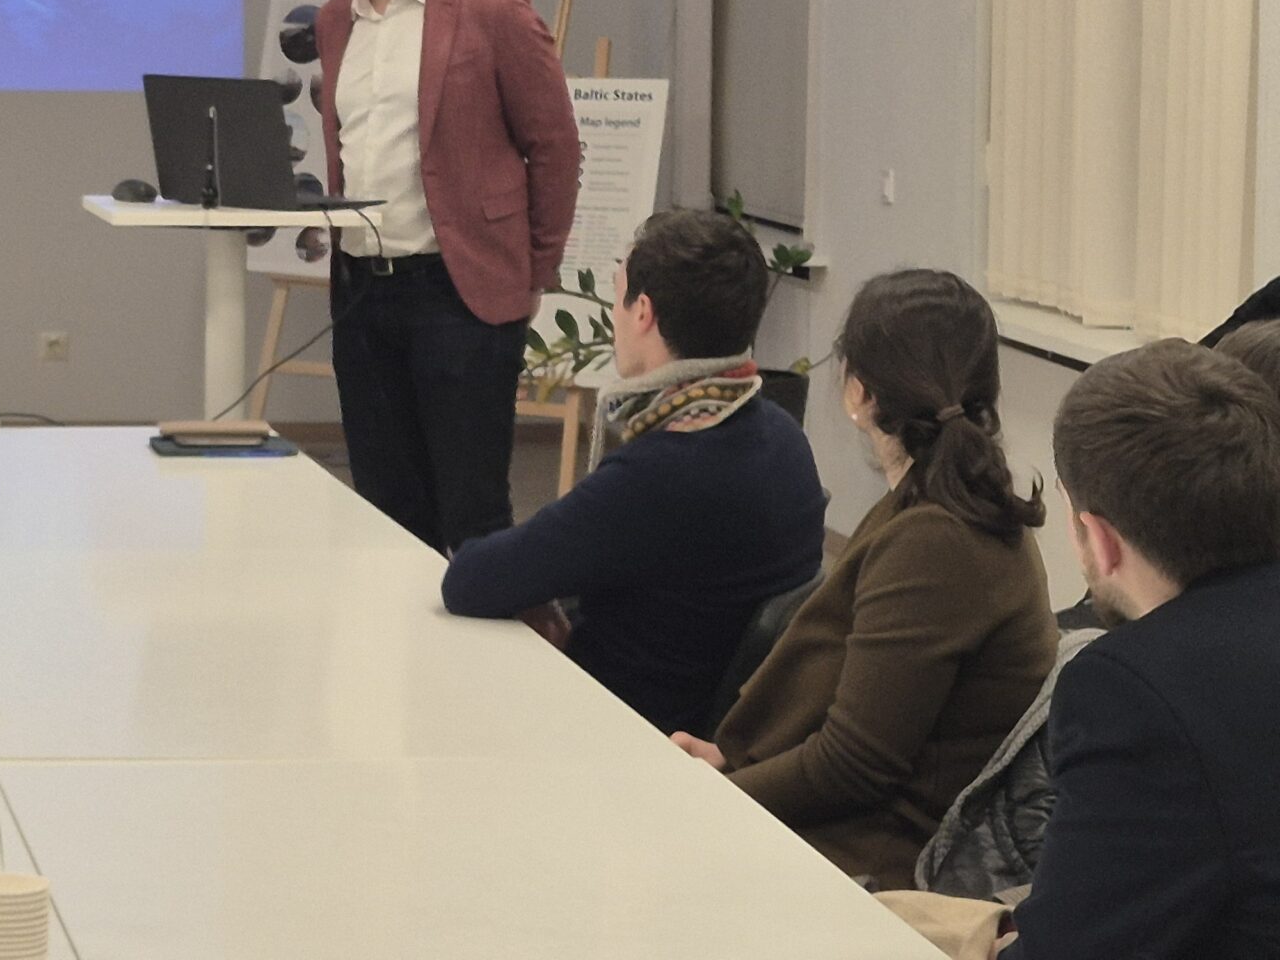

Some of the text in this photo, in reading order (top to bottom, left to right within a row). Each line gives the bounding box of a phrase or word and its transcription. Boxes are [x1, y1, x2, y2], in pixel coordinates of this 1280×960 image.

[574, 88, 653, 101] Baltic States
[580, 116, 641, 129] Map legend
